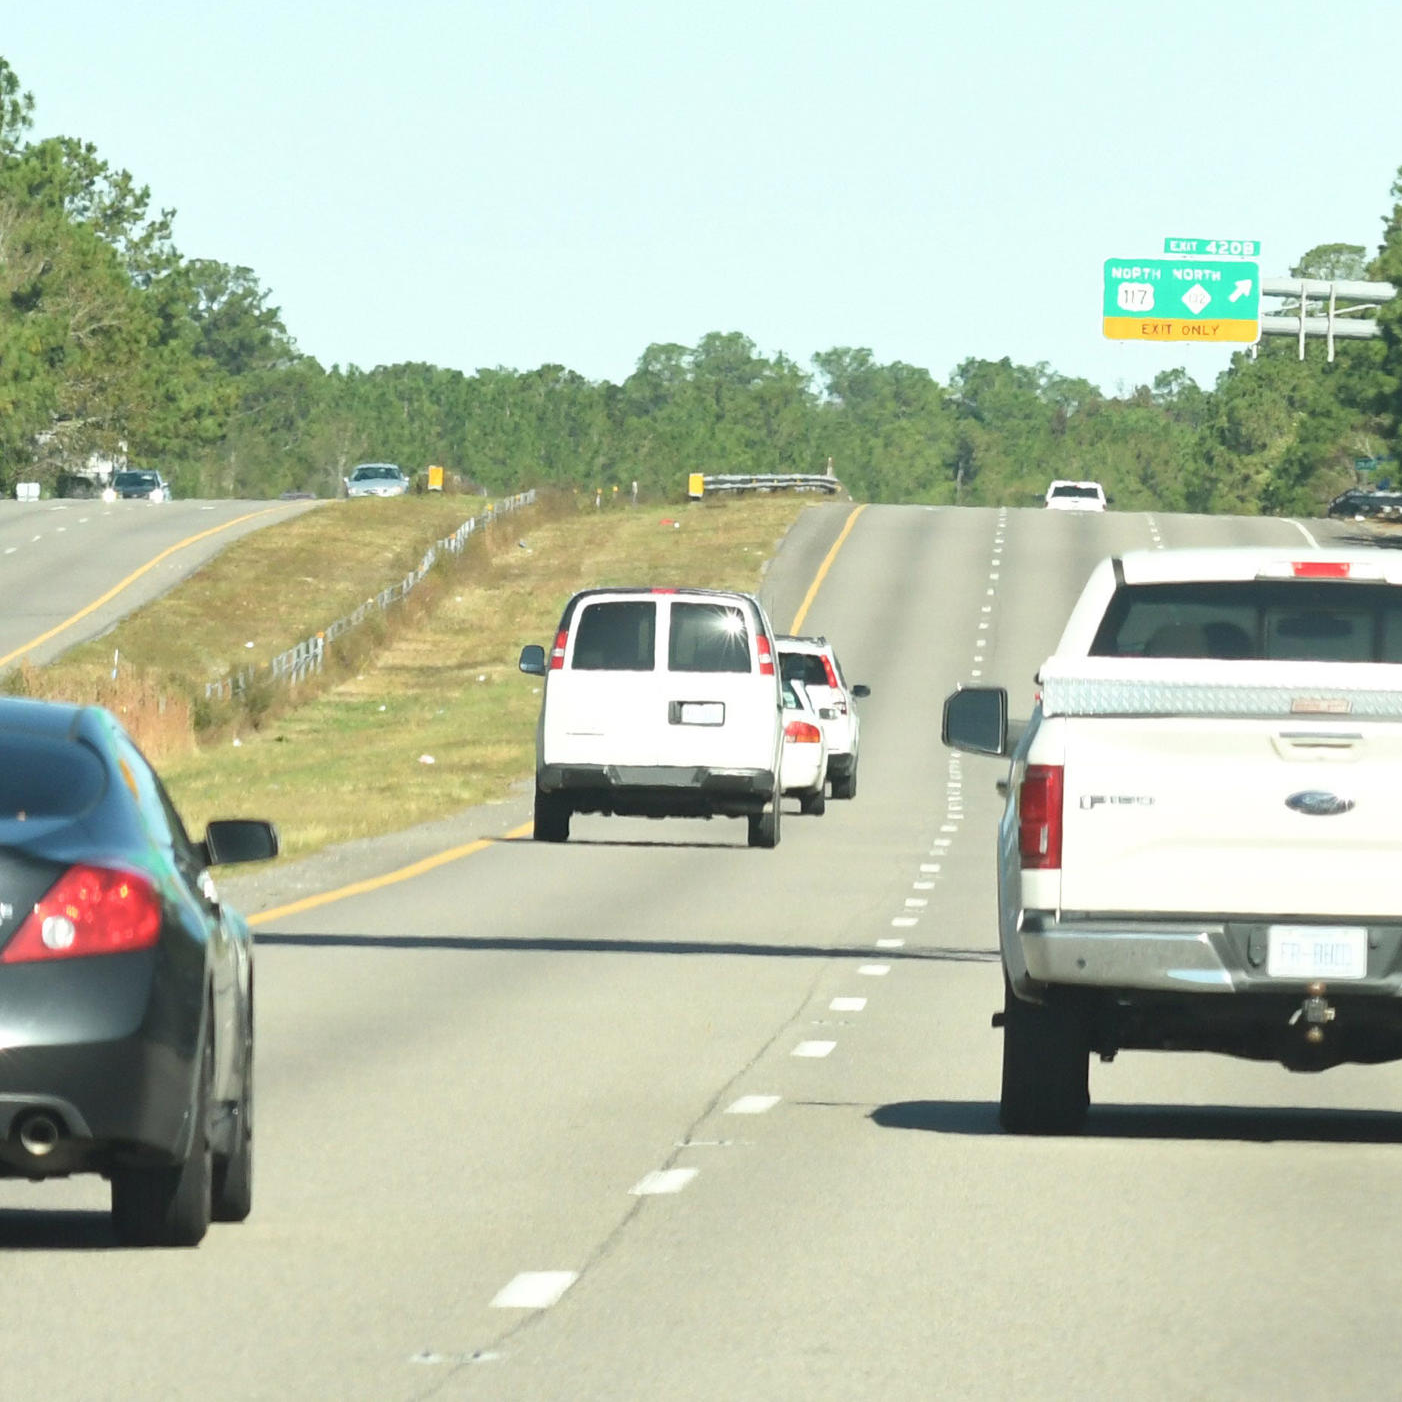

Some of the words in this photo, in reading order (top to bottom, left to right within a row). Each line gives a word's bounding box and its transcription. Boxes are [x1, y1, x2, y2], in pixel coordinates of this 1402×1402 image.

[1170, 240, 1197, 251] EXIT
[1112, 267, 1161, 279] NORTH
[1172, 269, 1221, 280] NORTH
[1124, 290, 1147, 304] 117
[1142, 324, 1172, 335] EXIT
[1182, 325, 1219, 336] ONLY
